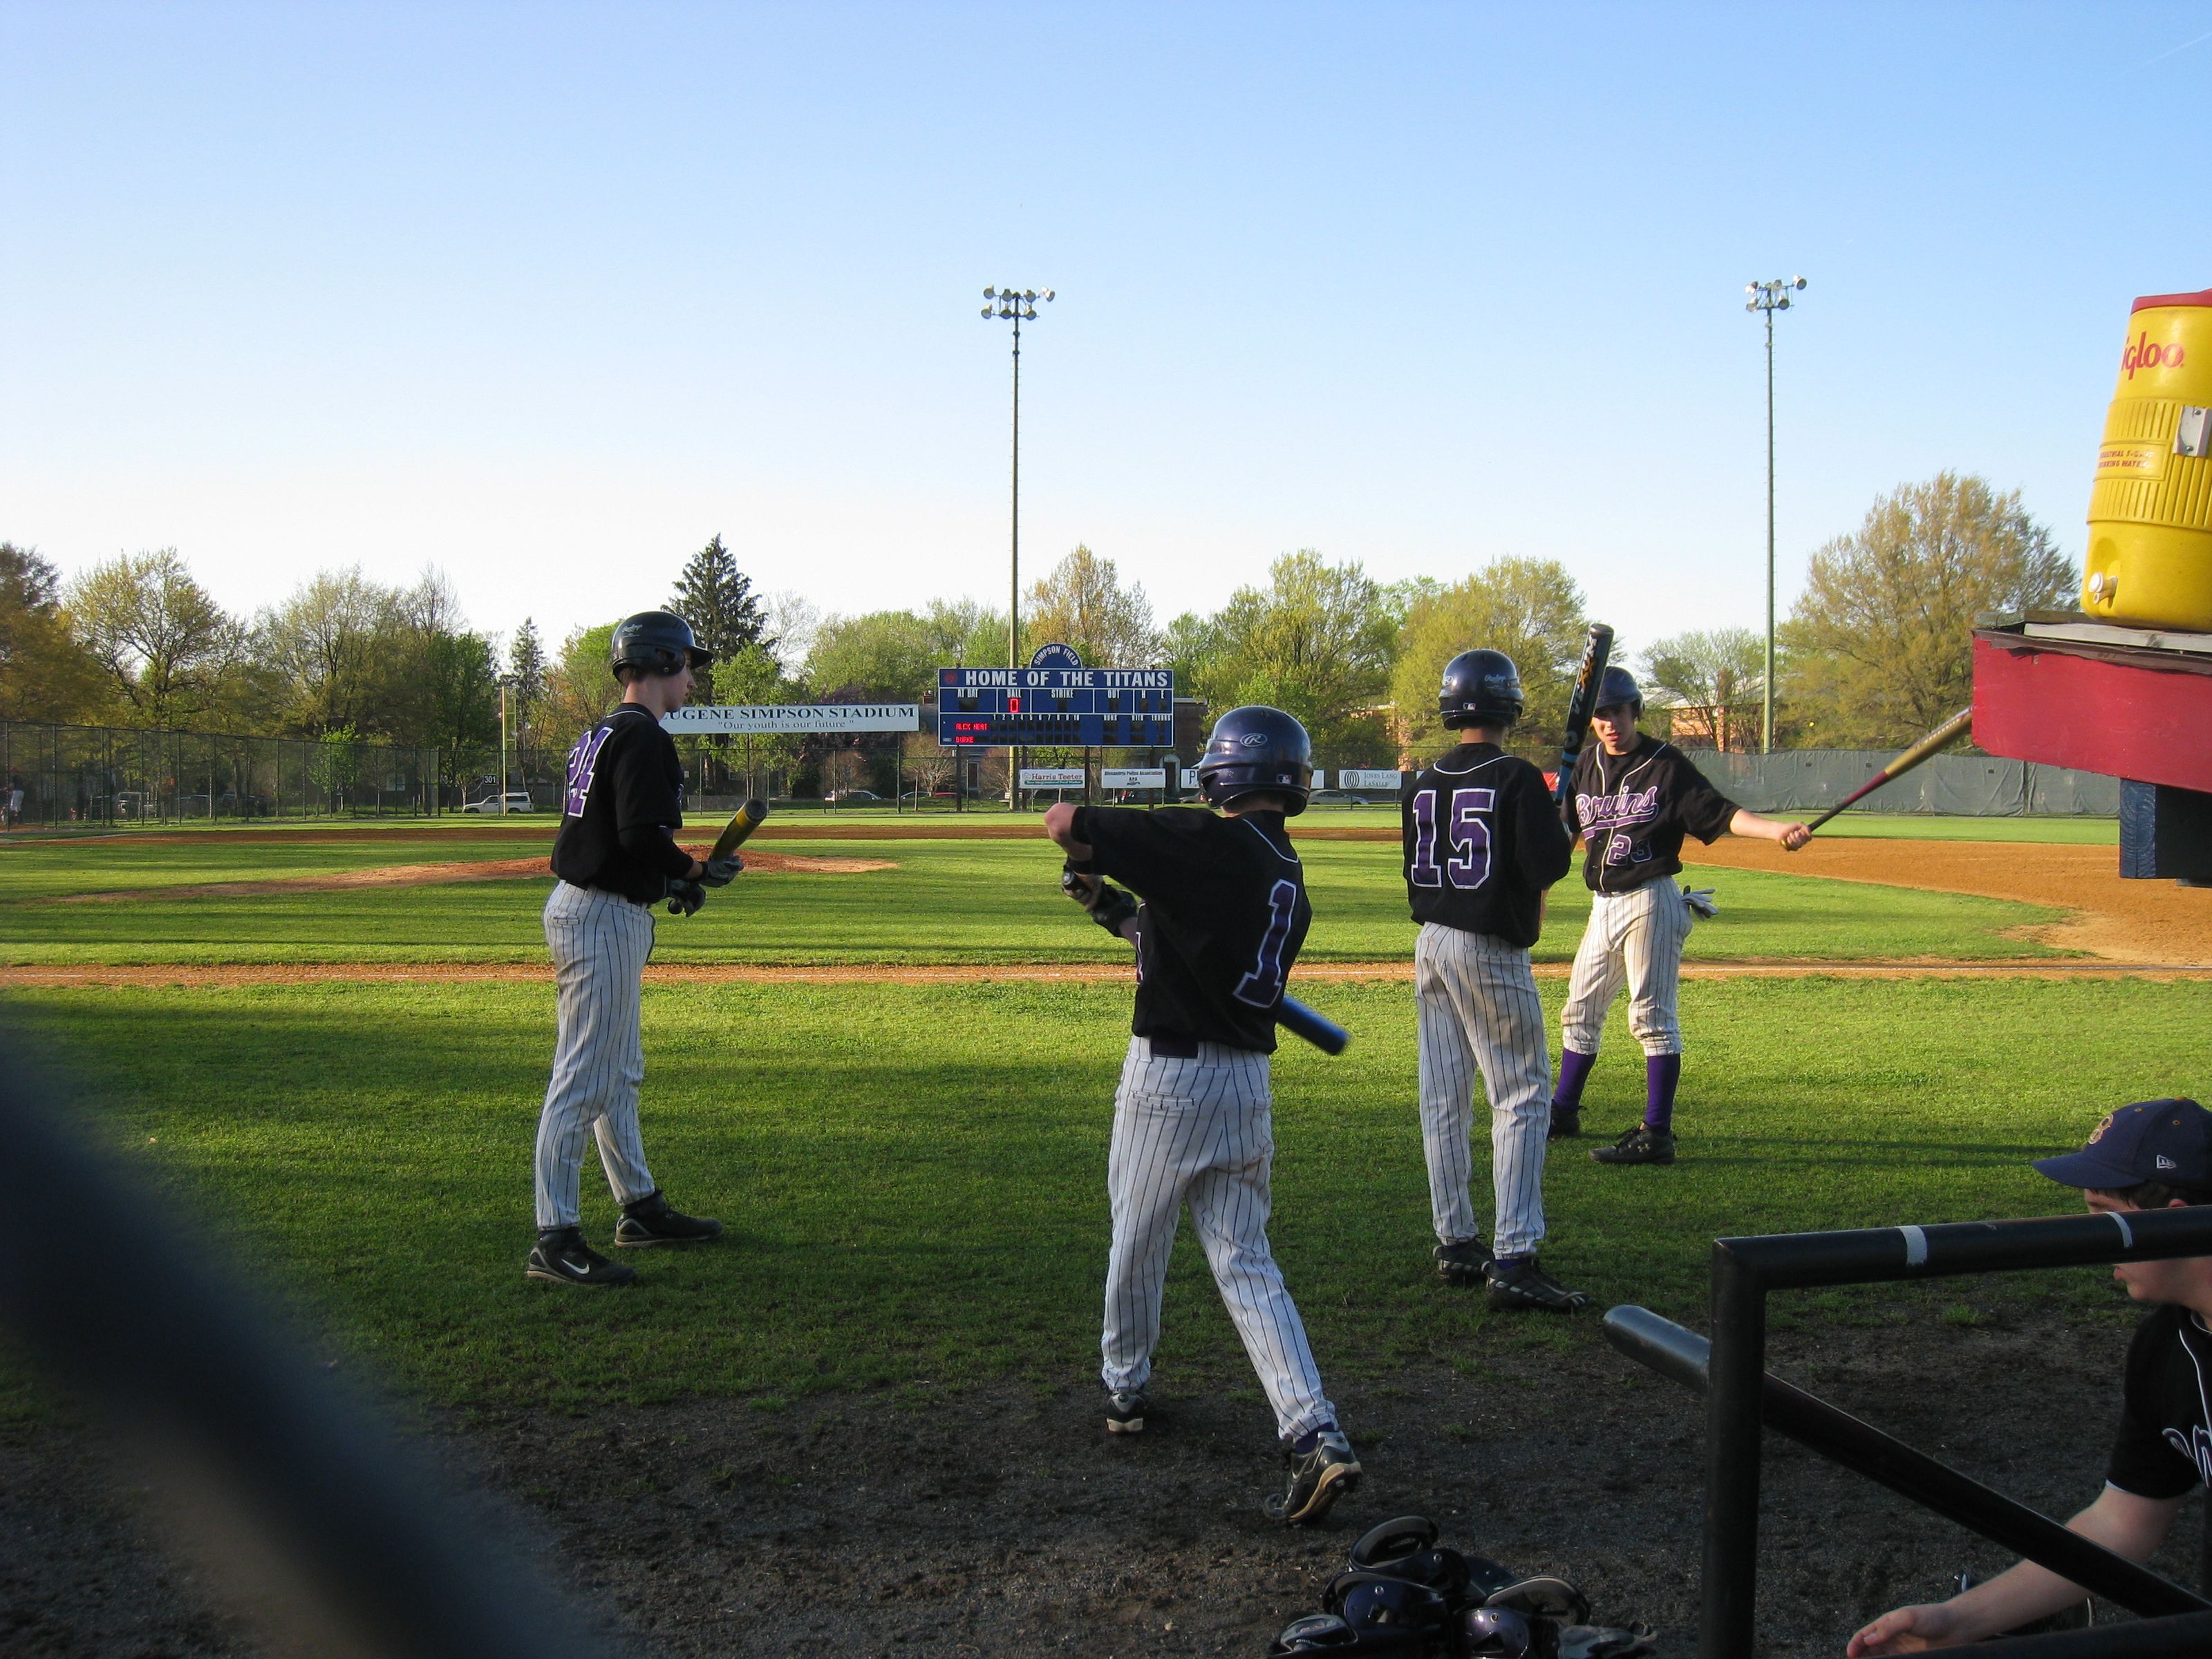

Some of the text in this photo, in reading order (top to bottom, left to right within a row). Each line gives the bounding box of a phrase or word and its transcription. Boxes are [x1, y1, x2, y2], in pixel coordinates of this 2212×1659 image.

[1033, 646, 1079, 666] SIMPSON FIELD
[965, 671, 1168, 687] HOME OF THE TITANS
[957, 689, 979, 698] AT BAT
[1006, 689, 1022, 698] BALL
[1051, 690, 1074, 699] STRIKE
[1107, 690, 1120, 699] OUT
[1141, 690, 1146, 699] H
[1161, 690, 1165, 699] E
[1010, 698, 1019, 713] 0
[740, 708, 824, 720] SIMPSON
[829, 707, 915, 718] STADIUM
[747, 721, 778, 731] youth
[815, 719, 846, 728] future
[1575, 785, 1659, 828] Bruins
[1410, 787, 1497, 890] 15
[1232, 878, 1297, 1009] 1
